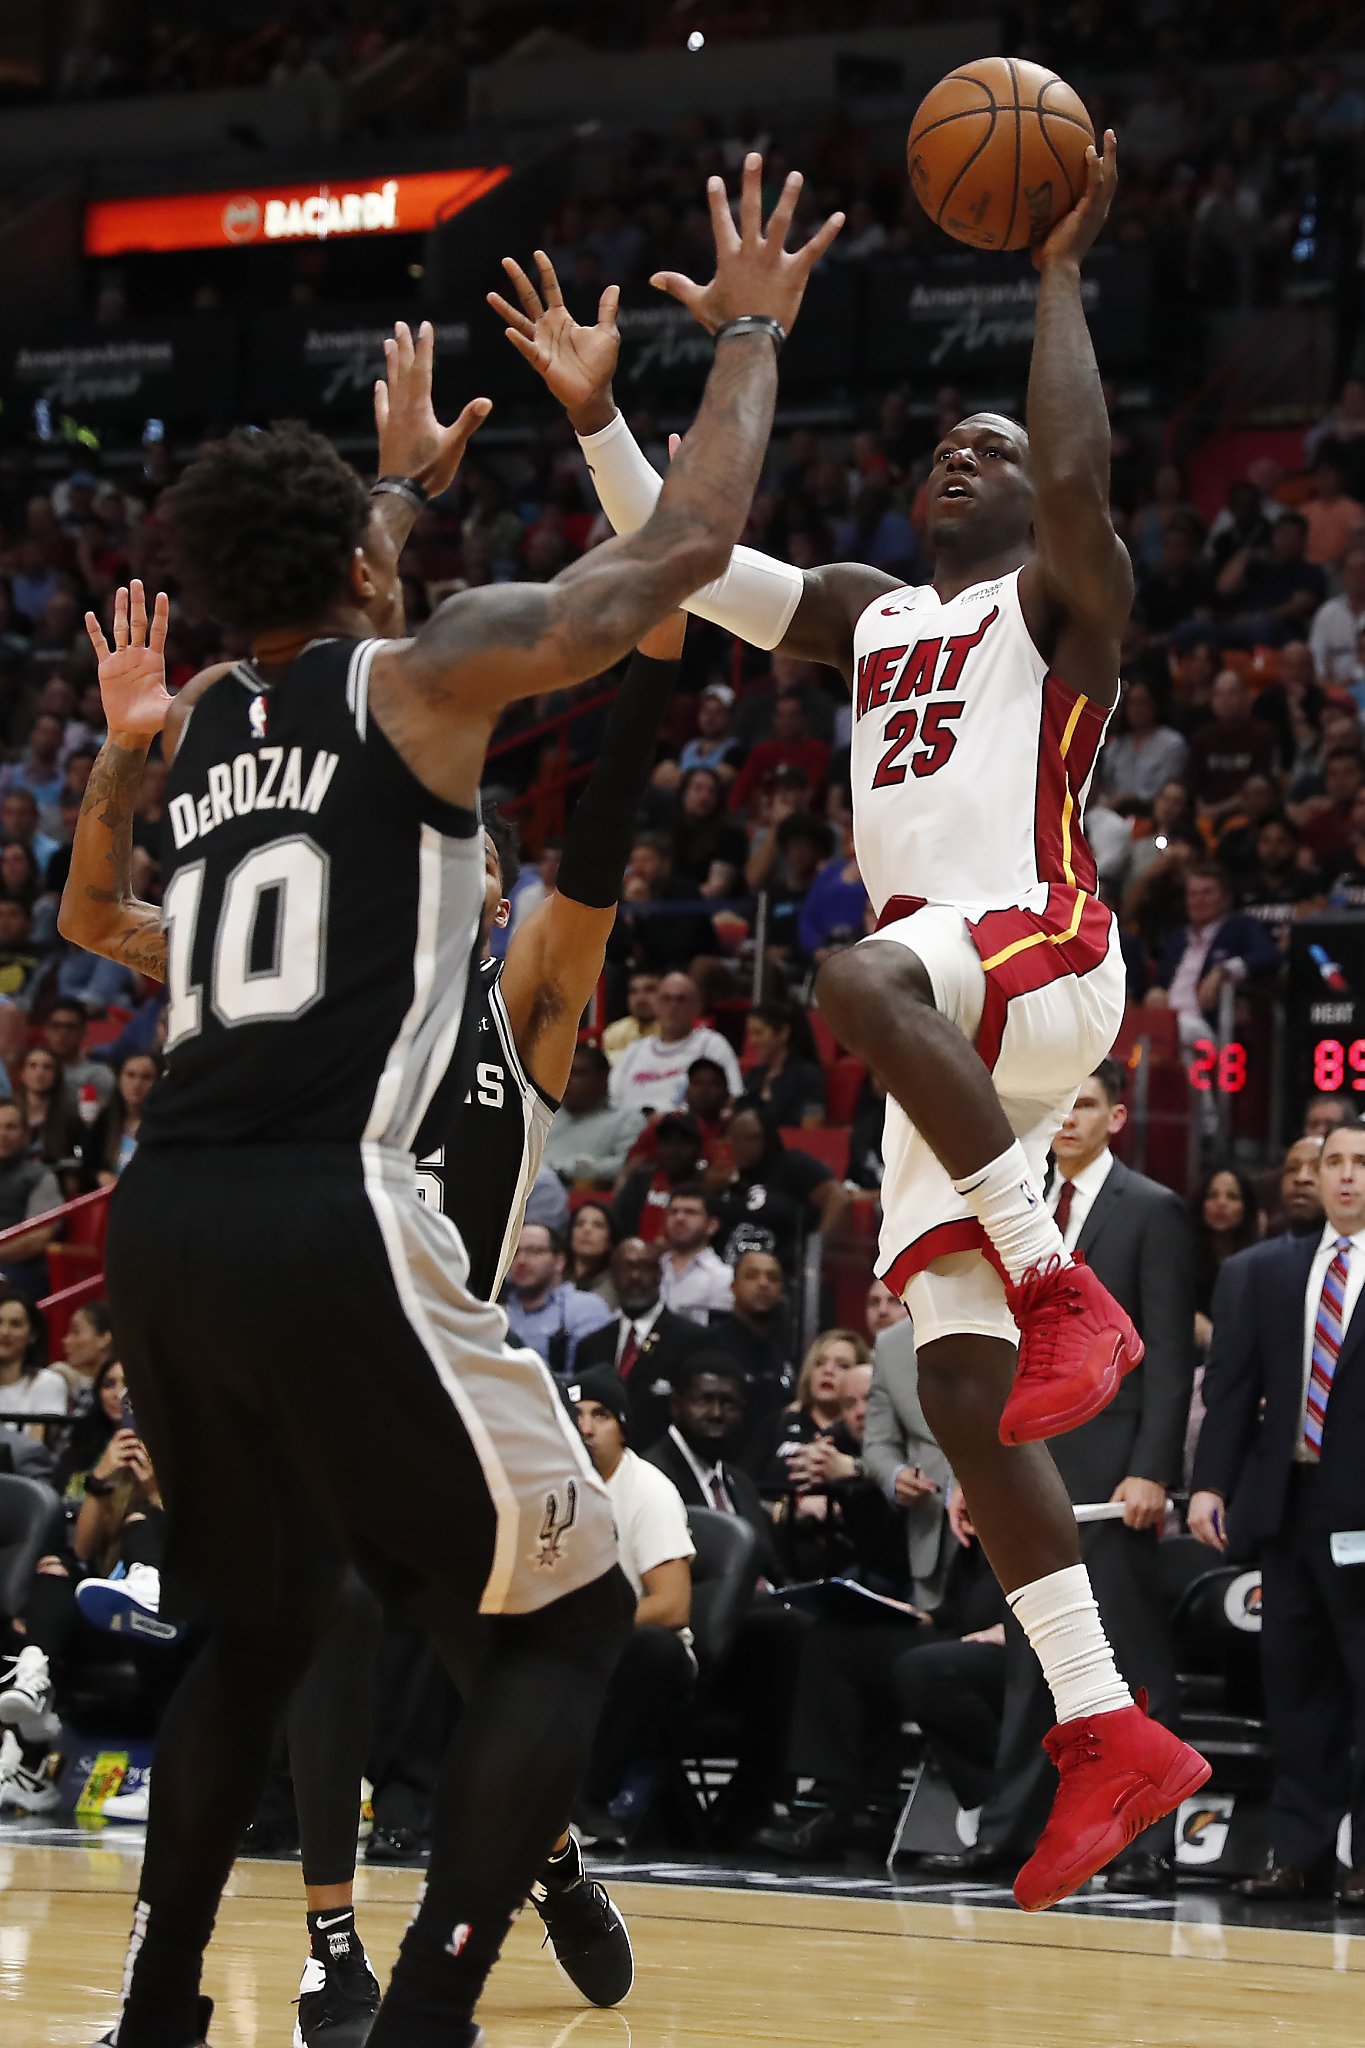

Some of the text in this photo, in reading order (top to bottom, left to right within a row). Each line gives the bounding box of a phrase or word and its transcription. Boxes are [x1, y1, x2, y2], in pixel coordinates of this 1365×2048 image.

[857, 605, 999, 723] HEAT
[871, 700, 966, 790] 25
[168, 746, 340, 850] DeROZAN
[162, 832, 331, 1055] 10
[1189, 1038, 1247, 1093] 28
